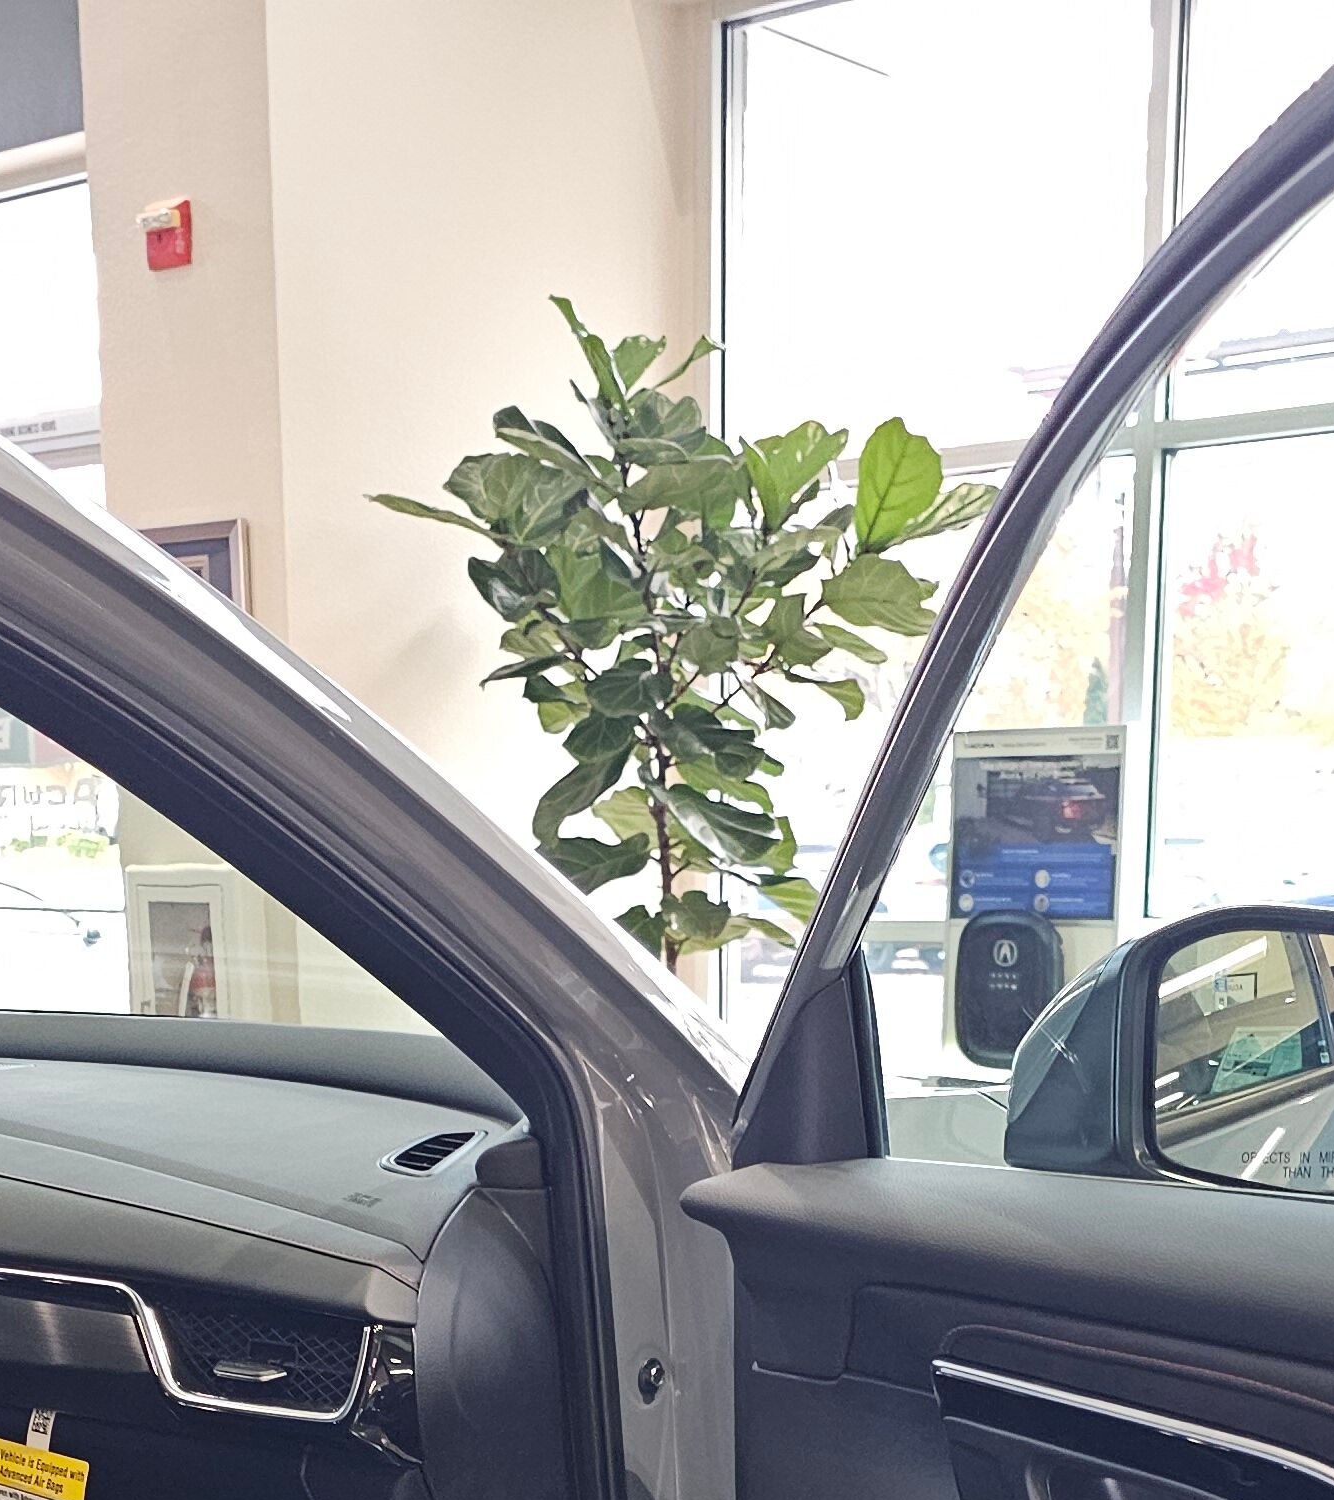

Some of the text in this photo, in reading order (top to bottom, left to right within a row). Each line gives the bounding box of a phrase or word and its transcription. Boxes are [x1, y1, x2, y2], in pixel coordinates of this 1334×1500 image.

[1299, 1151, 1310, 1163] IN
[1283, 1166, 1311, 1178] THAN
[0, 1448, 26, 1467] Vehicle
[28, 1456, 34, 1468] is
[36, 1458, 69, 1478] Equipped
[69, 1469, 85, 1482] with
[33, 1475, 45, 1488] Air
[46, 1478, 64, 1494] Bags
